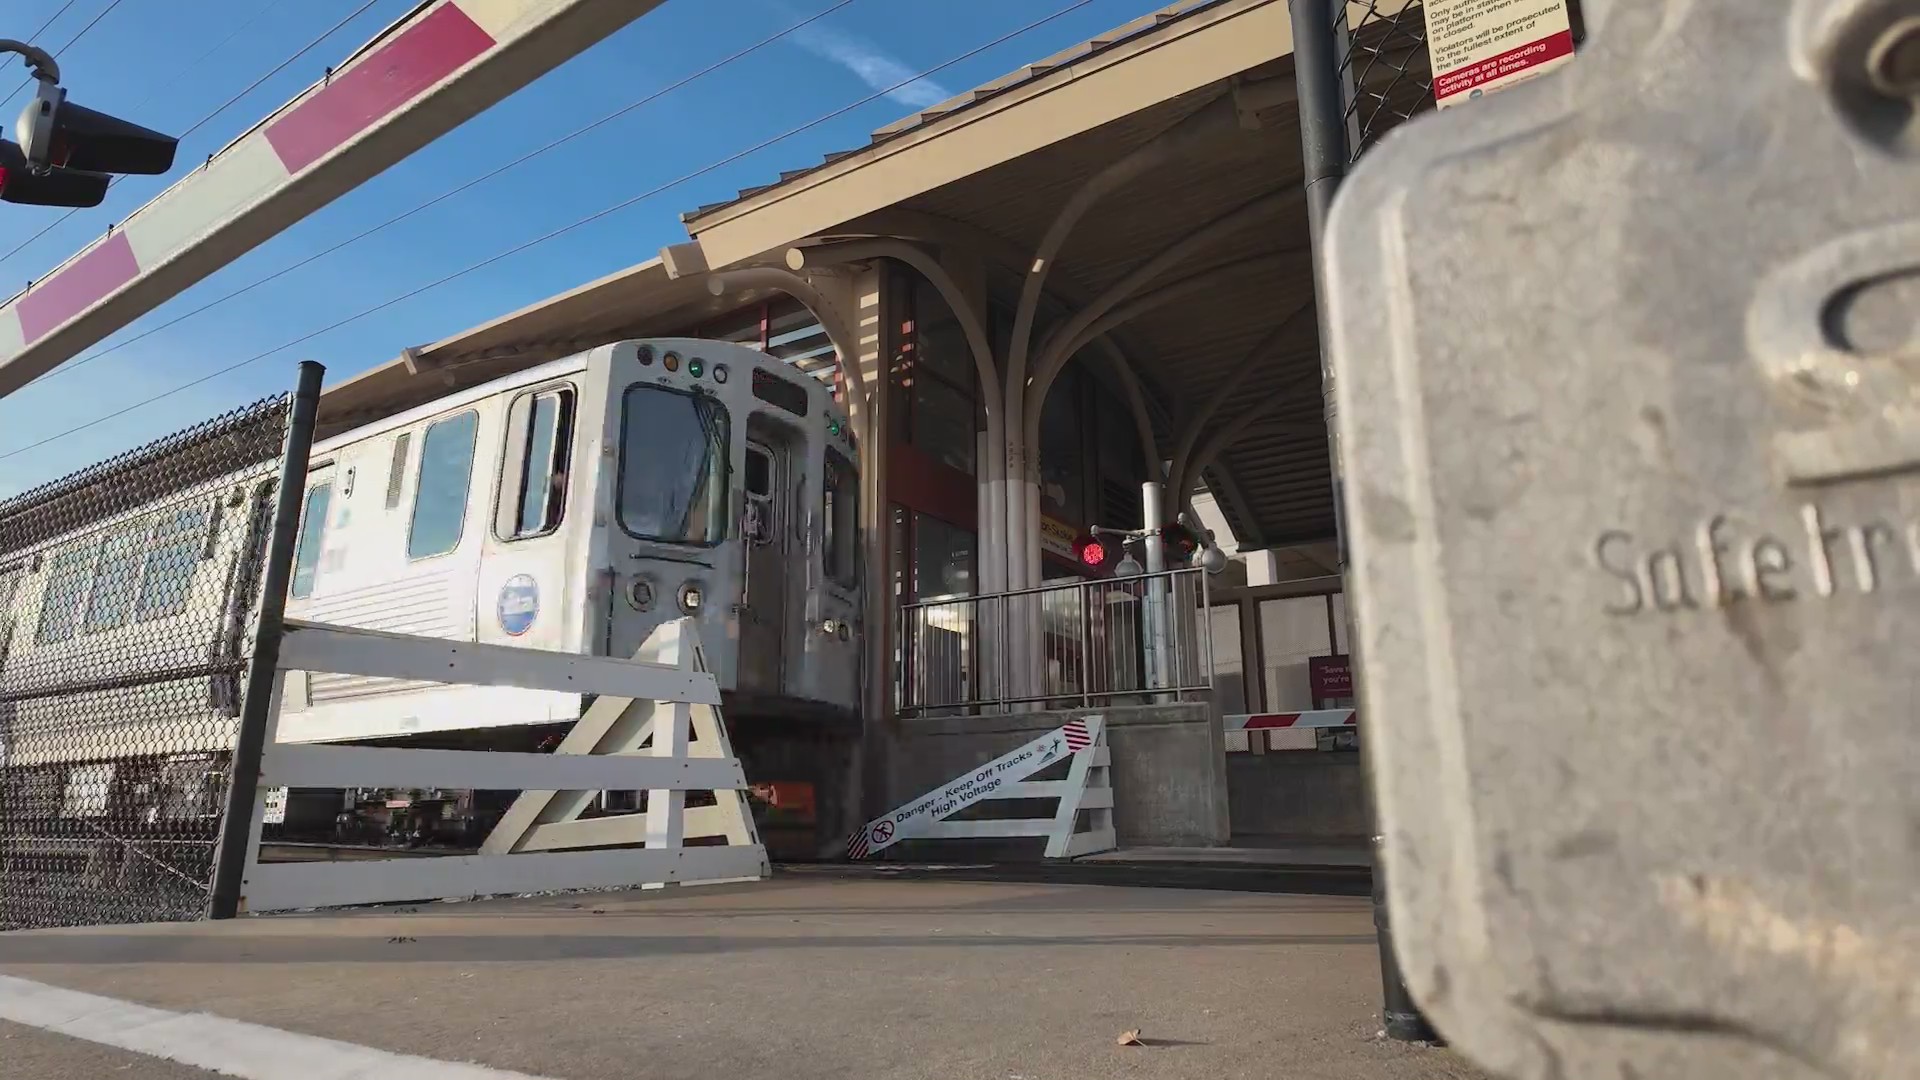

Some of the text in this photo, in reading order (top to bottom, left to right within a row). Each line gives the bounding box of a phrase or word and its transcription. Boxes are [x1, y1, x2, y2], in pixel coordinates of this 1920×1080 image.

[1430, 8, 1450, 19] Only
[1431, 16, 1450, 27] may
[1452, 11, 1463, 19] be
[1432, 0, 1511, 35] on platform when
[1435, 3, 1560, 54] Violators will be prosecuted
[1443, 22, 1476, 39] closed.
[1447, 50, 1461, 59] the
[1463, 37, 1492, 53] fullest
[1494, 26, 1523, 41] extent
[1526, 20, 1536, 30] of
[1437, 55, 1471, 71] the law.
[1438, 66, 1480, 87] Cameras
[1481, 60, 1498, 72] are
[1498, 43, 1546, 65] recording
[1440, 78, 1473, 95] activity
[1474, 72, 1485, 83] at
[1485, 68, 1498, 79] all
[1499, 59, 1529, 74] times.
[1595, 502, 1920, 618] Safetr
[1322, 675, 1350, 686] you're
[896, 798, 936, 823] Danger
[945, 780, 974, 798] Keep
[976, 767, 993, 782] Off
[995, 751, 1033, 772] Tracks
[931, 778, 1001, 817] High Voltage
